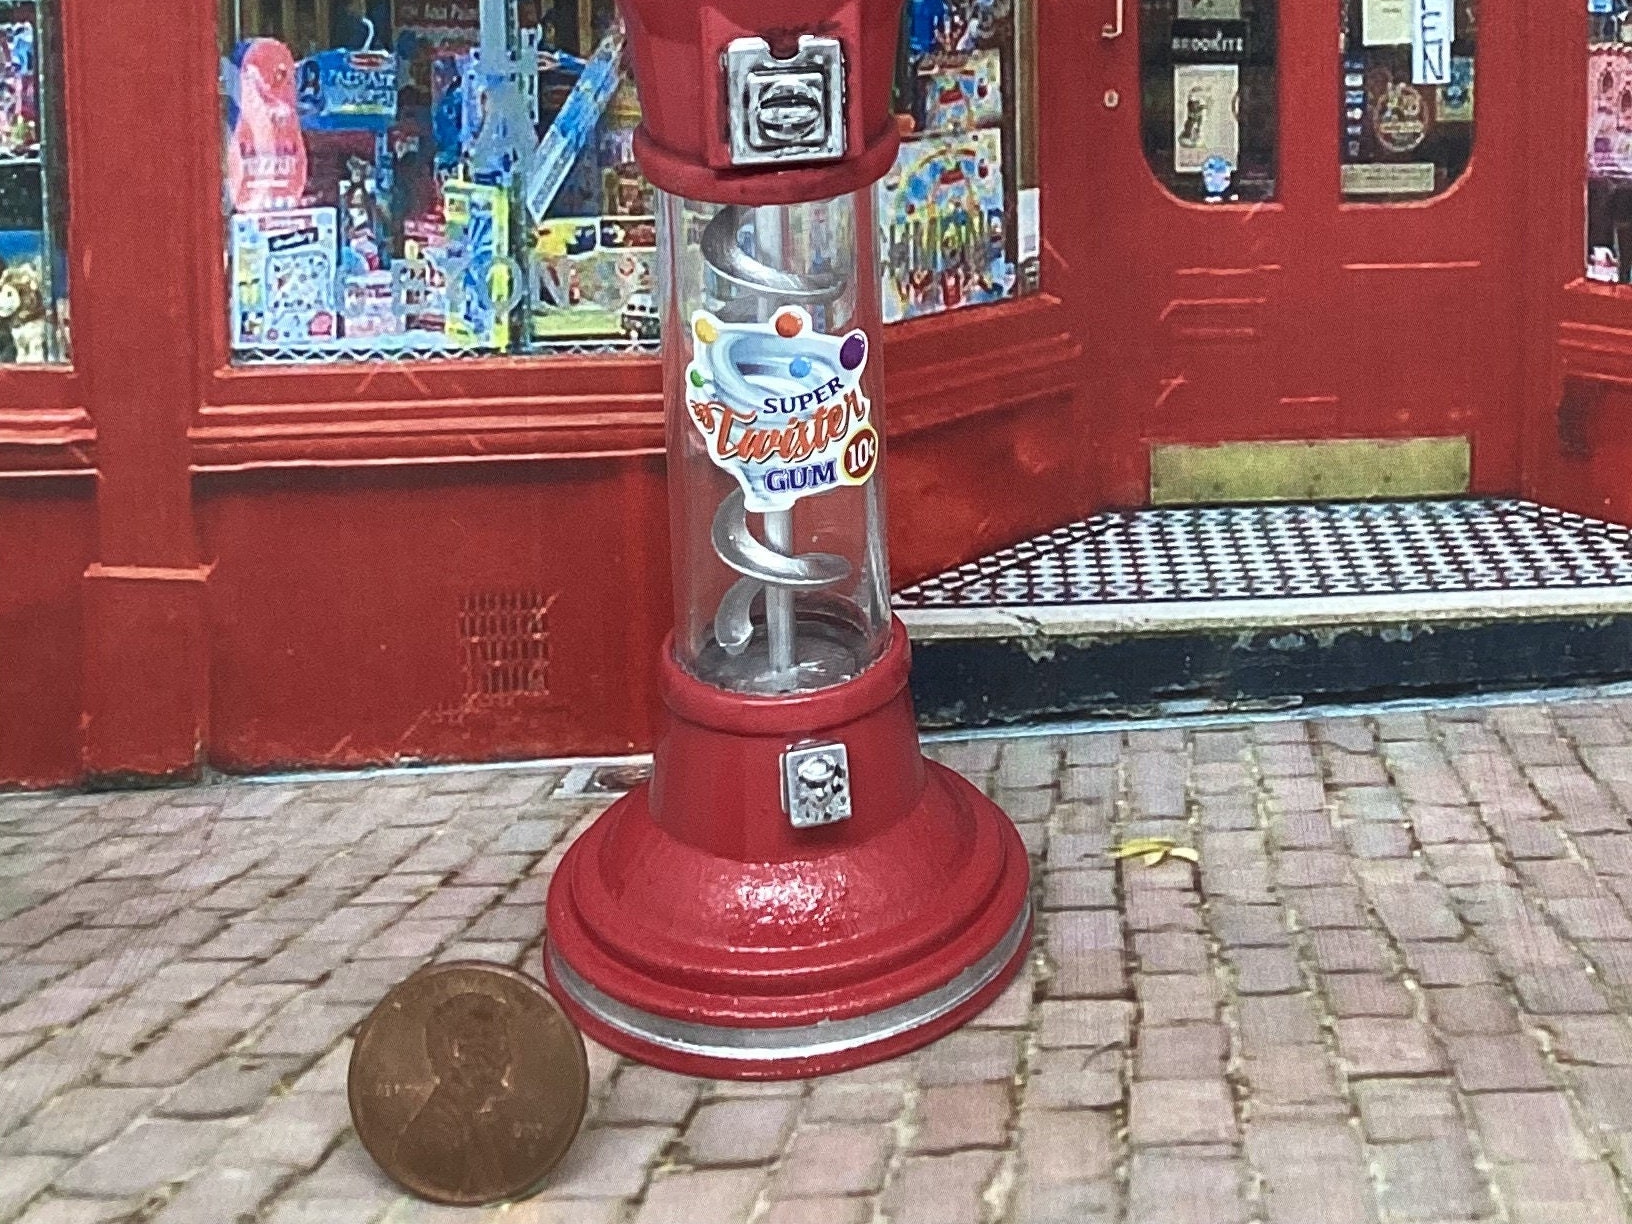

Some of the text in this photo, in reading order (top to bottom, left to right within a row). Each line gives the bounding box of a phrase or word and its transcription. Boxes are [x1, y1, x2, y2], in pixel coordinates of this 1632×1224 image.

[762, 376, 844, 415] SUPER
[690, 388, 865, 464] Twister
[764, 457, 839, 494] GUM
